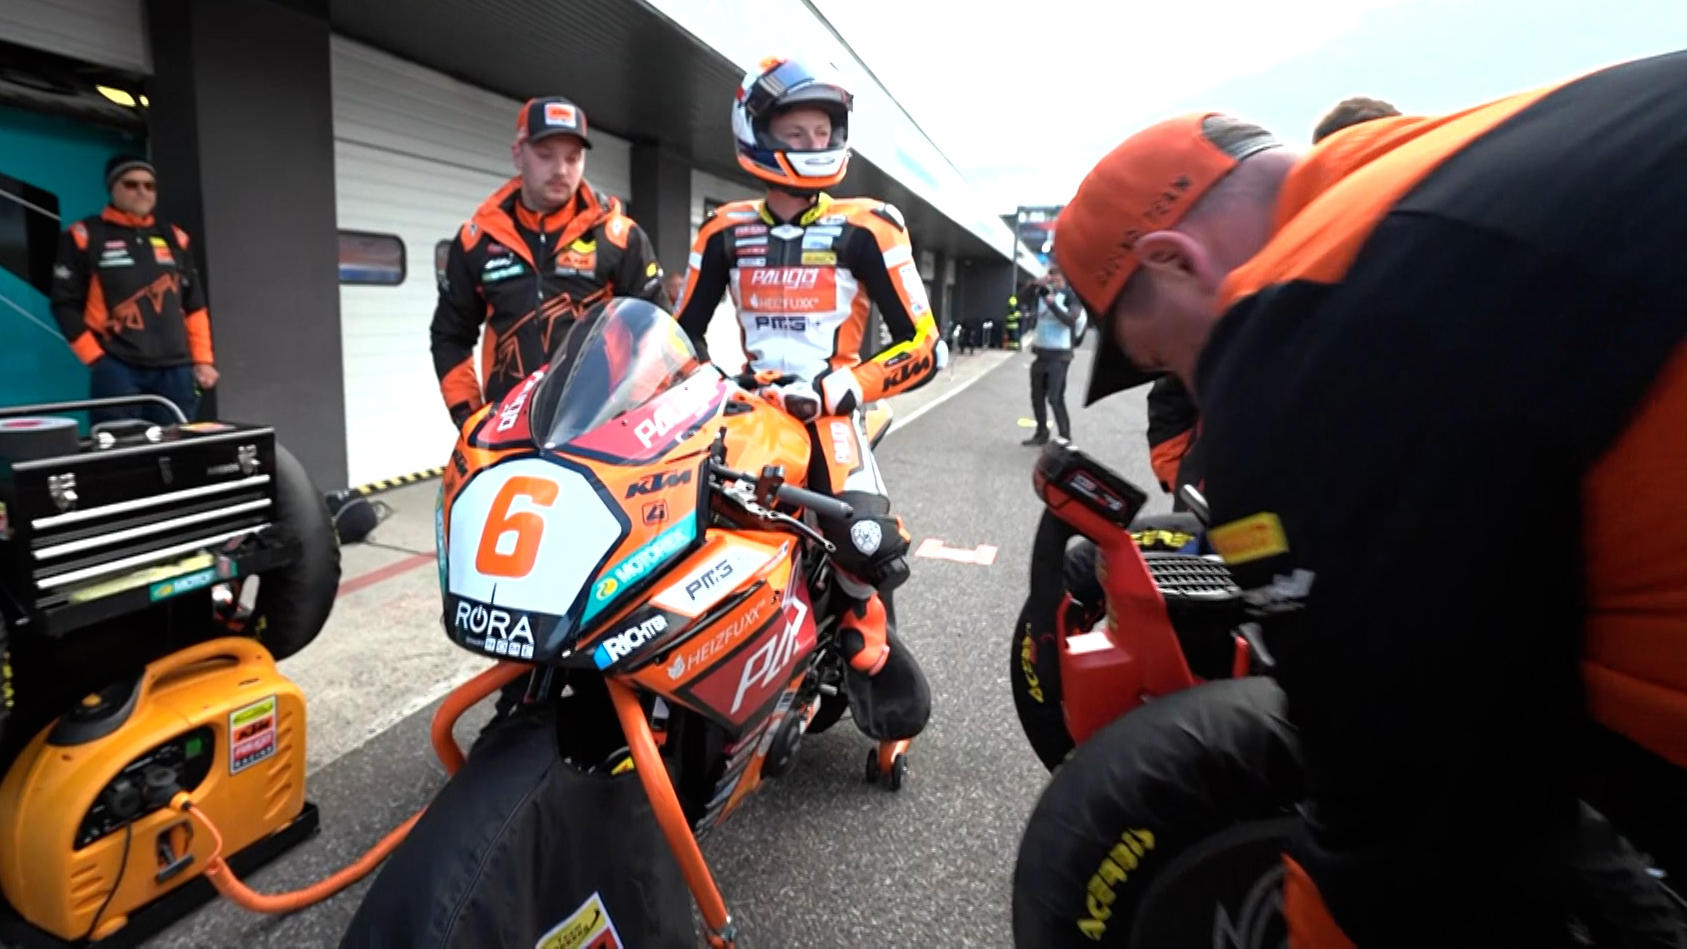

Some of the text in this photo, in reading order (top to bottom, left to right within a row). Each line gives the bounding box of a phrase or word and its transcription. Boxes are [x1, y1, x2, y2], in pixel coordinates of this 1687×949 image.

[883, 356, 930, 392] KTM
[625, 469, 692, 499] KTM
[475, 476, 560, 580] 6
[455, 601, 534, 644] RORA
[602, 614, 668, 663] RICHTER
